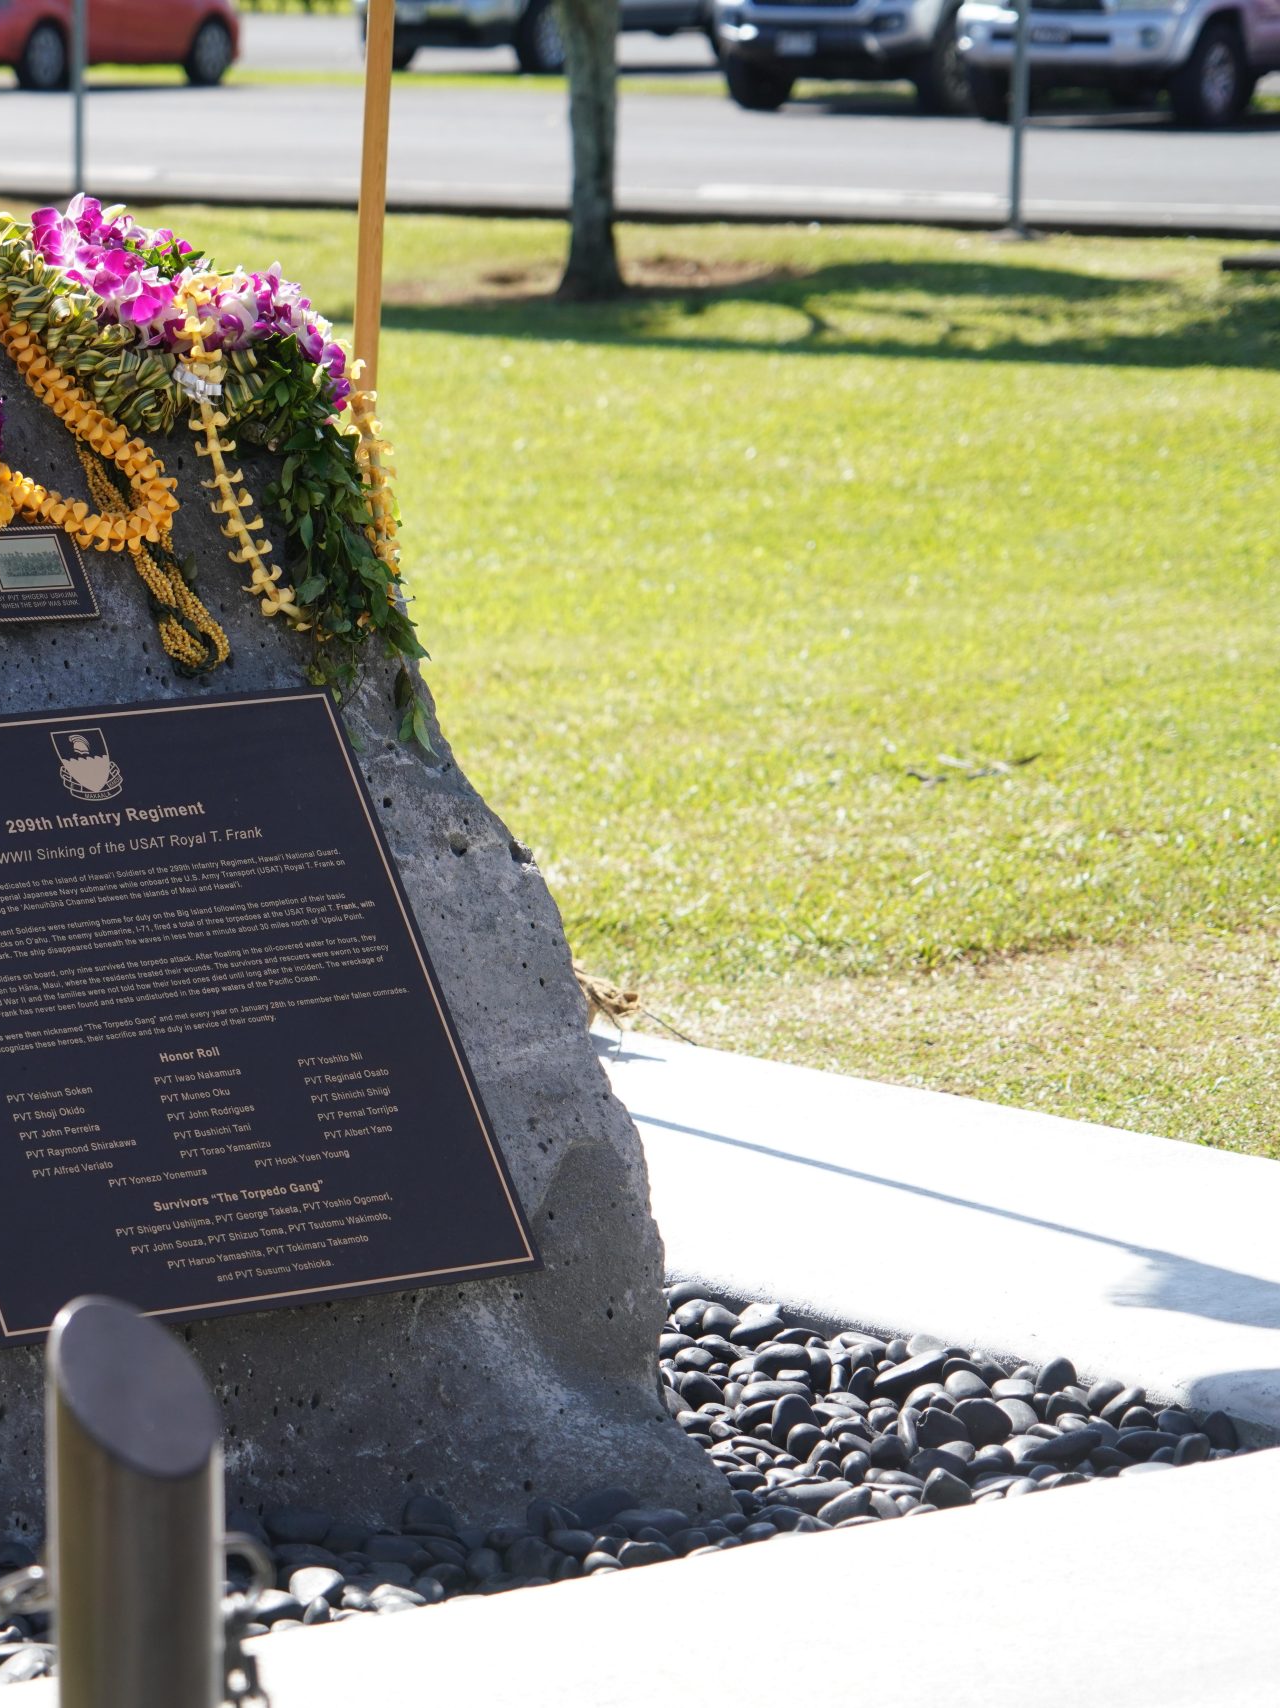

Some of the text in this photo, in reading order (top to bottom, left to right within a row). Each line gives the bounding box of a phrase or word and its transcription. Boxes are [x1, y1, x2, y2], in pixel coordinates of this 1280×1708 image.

[6, 802, 205, 833] 299th Infantry Regiment
[37, 846, 85, 860] Sinking
[89, 842, 101, 855] of
[105, 842, 125, 853] the
[130, 836, 165, 850] USAT
[170, 832, 206, 847] Royal
[210, 831, 221, 842] T.
[226, 827, 262, 840] Frank
[23, 890, 58, 900] Japanese
[79, 884, 118, 893] submarine
[119, 881, 138, 889] while
[139, 877, 170, 887] onboard
[183, 874, 200, 882] U.S.
[220, 868, 256, 878] Transport
[256, 865, 283, 876] (USAT)
[283, 863, 305, 872] Royal
[313, 860, 335, 868] Frank
[34, 1041, 56, 1049] these
[57, 1037, 86, 1046] heroes,
[86, 1034, 104, 1042] their
[105, 1031, 137, 1040] sacrifice
[138, 1028, 153, 1036] and
[167, 1025, 183, 1033] duty
[193, 1021, 220, 1030] service
[220, 1019, 228, 1027] of
[229, 1017, 246, 1025] their
[247, 1014, 276, 1023] country.
[159, 1047, 220, 1062] Honor Roll
[297, 1051, 363, 1067] PVT Yoshito Nii
[154, 1068, 242, 1085] PVT Iwao Nakamura
[304, 1068, 389, 1085] PVT Reginald Osato
[6, 1086, 93, 1103] PVT Yeishun Soken
[160, 1088, 231, 1103] PVT Muneo Oku
[310, 1086, 391, 1104] PVT Shinichi Shiigi
[12, 1106, 85, 1122] PVT Shoji Okido
[166, 1105, 255, 1122] PVT John Rodrigues
[317, 1105, 399, 1122] PVT Pernal Torrijos
[19, 1124, 101, 1141] PVT John Perreira
[173, 1123, 252, 1140] PVT Bushichi Tani
[323, 1125, 393, 1140] PVT Albert Yano
[25, 1139, 137, 1159] PVT Raymond Shirakawa
[179, 1140, 272, 1159] PVT Torao Yamamizu
[254, 1150, 350, 1168] PVT Hook Yuen Young
[32, 1161, 114, 1178] PVT Alfred Veriato
[108, 1168, 208, 1188] PVT Yonezo Yonemura
[153, 1198, 209, 1211] Survivors
[240, 1186, 287, 1199] Torpedo
[115, 1192, 393, 1237] PVT Shigeru Ushijima, PVT George Taketa, PVT Yoshio Ogomori,
[130, 1212, 392, 1255] PVT John Souza, PVT Shizuo Toma, PVT Tsutomu Wakimoto,
[167, 1234, 369, 1269] PVT Haruo Yamashita, PVT Tokimaru Takamoto
[217, 1259, 334, 1282] and PVT Susumu Yoshioka.
